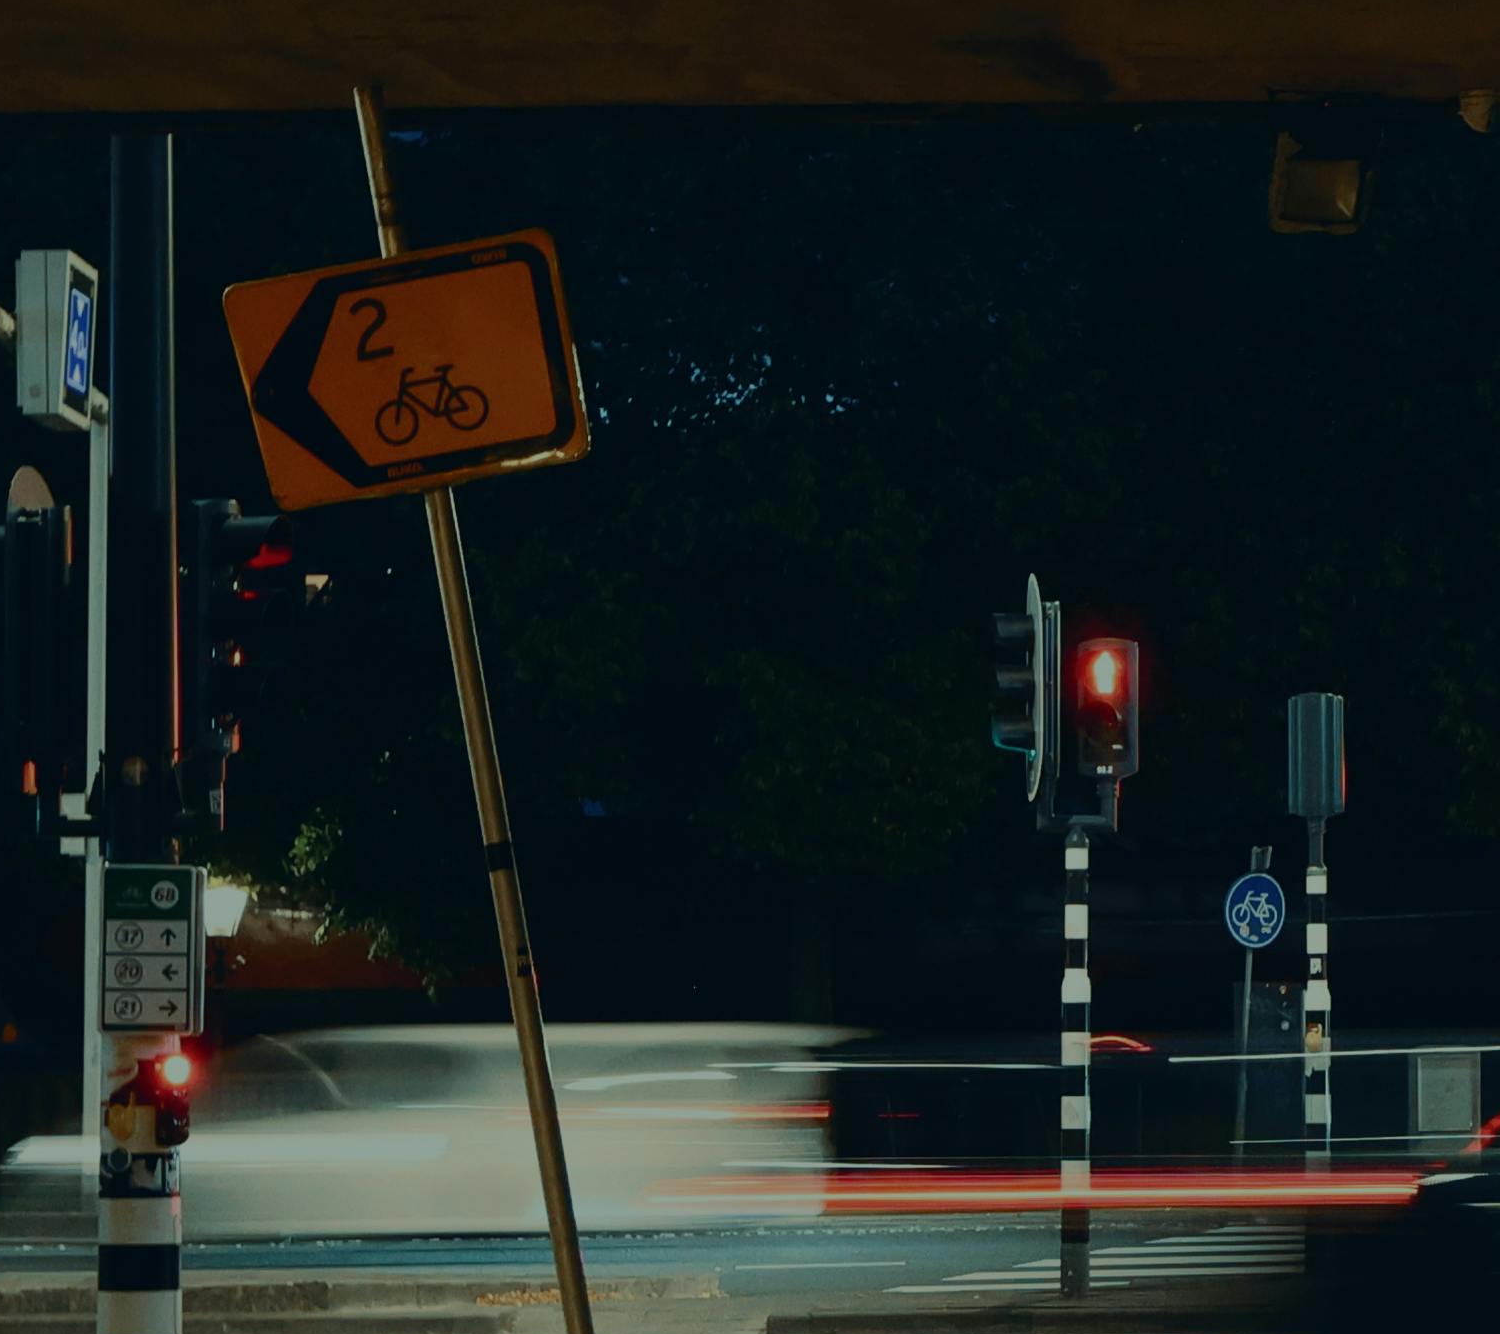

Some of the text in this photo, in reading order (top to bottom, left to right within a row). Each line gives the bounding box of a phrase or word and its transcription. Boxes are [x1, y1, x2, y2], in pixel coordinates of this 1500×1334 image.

[349, 298, 394, 362] 2
[154, 886, 175, 902] 68
[121, 928, 139, 945] 37
[119, 963, 139, 979] 20
[119, 1000, 137, 1016] 21
